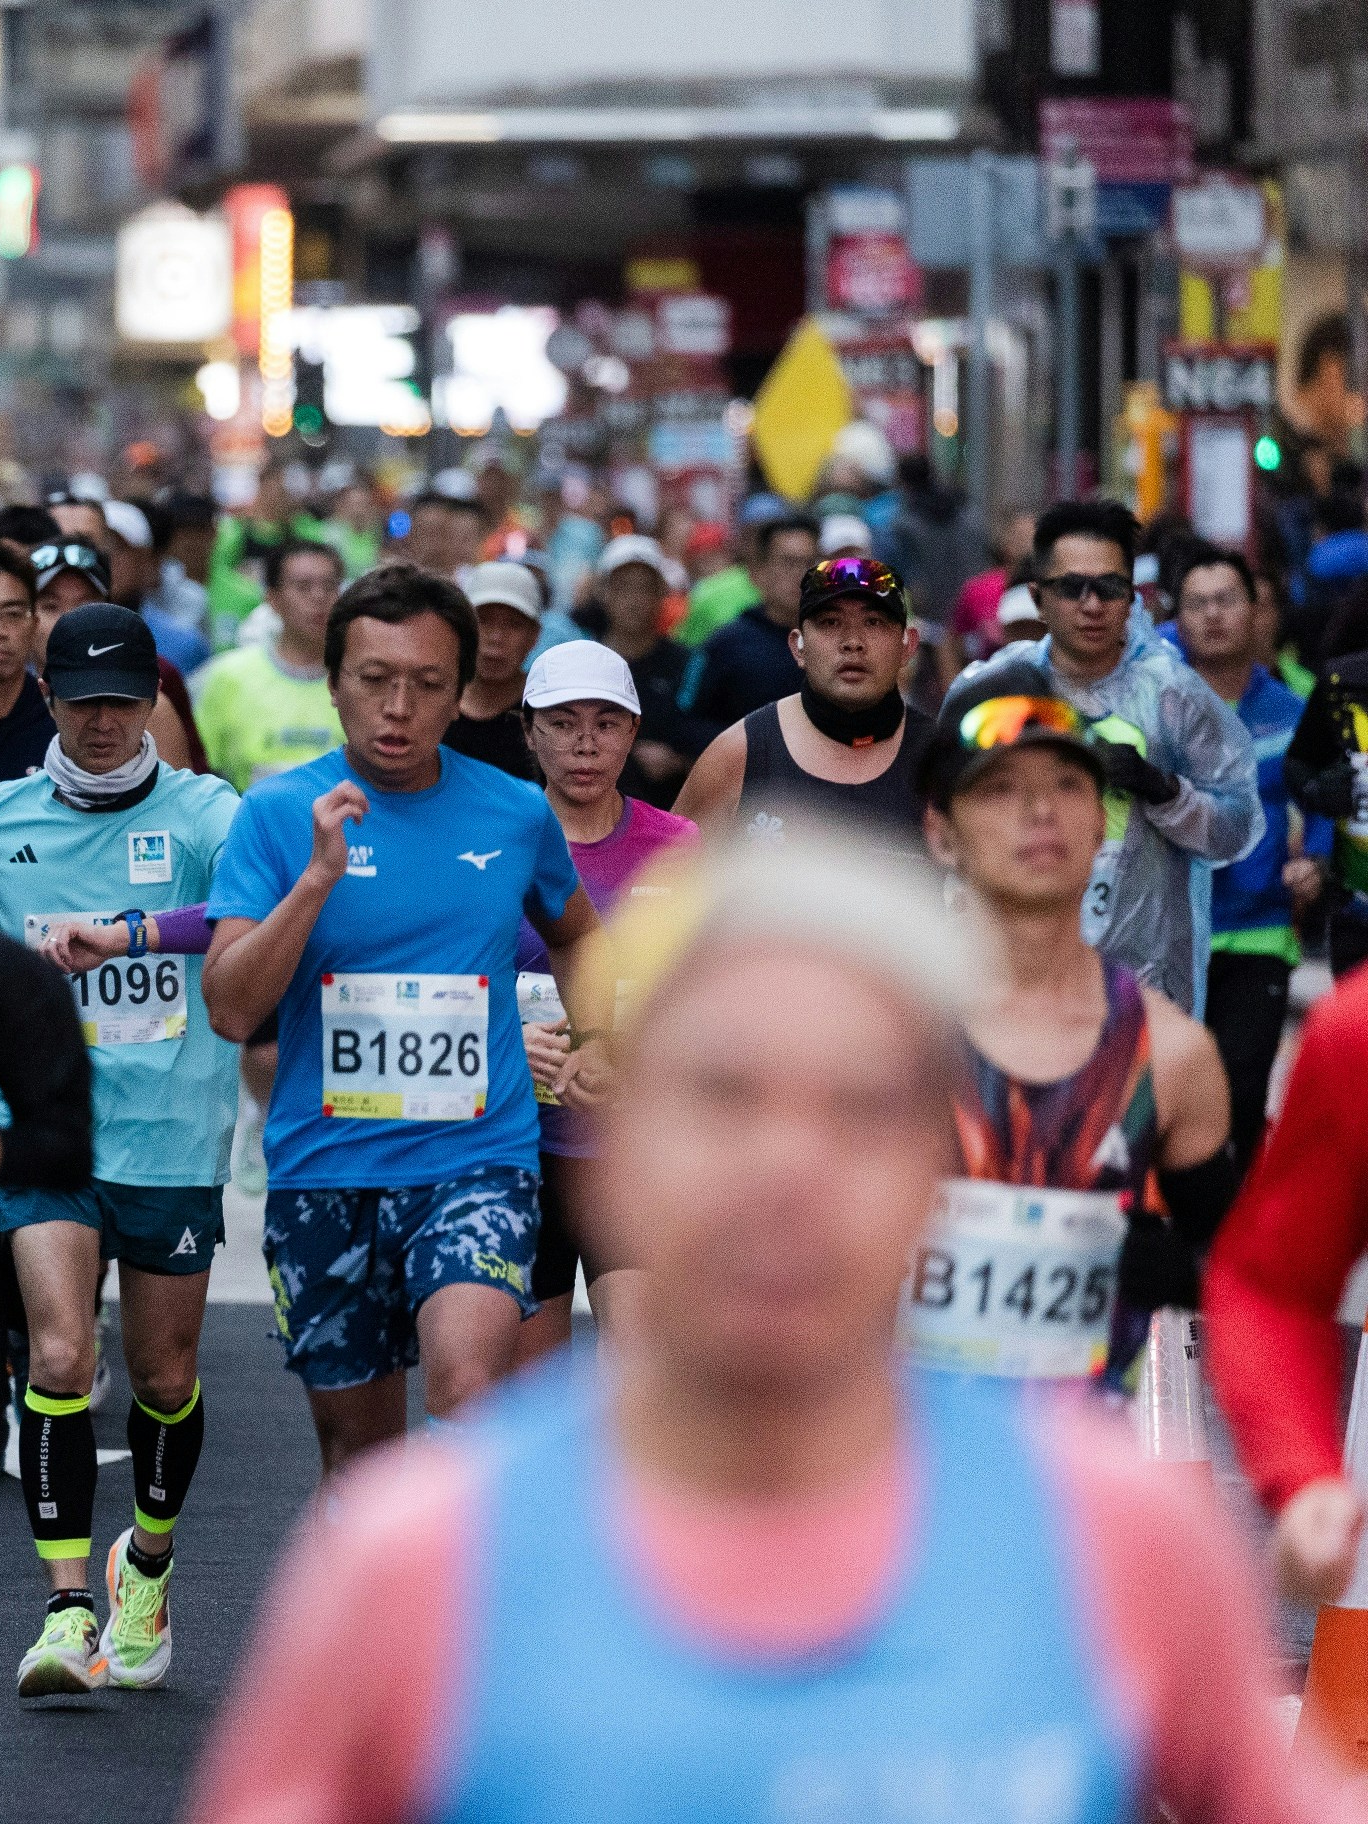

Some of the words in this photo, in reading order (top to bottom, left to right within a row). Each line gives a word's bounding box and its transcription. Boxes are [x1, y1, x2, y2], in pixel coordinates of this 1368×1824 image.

[72, 960, 180, 1007] 1096
[331, 1029, 481, 1077] B1826
[911, 1246, 1113, 1325] B1425
[39, 1416, 52, 1498] COMPRESSPORT
